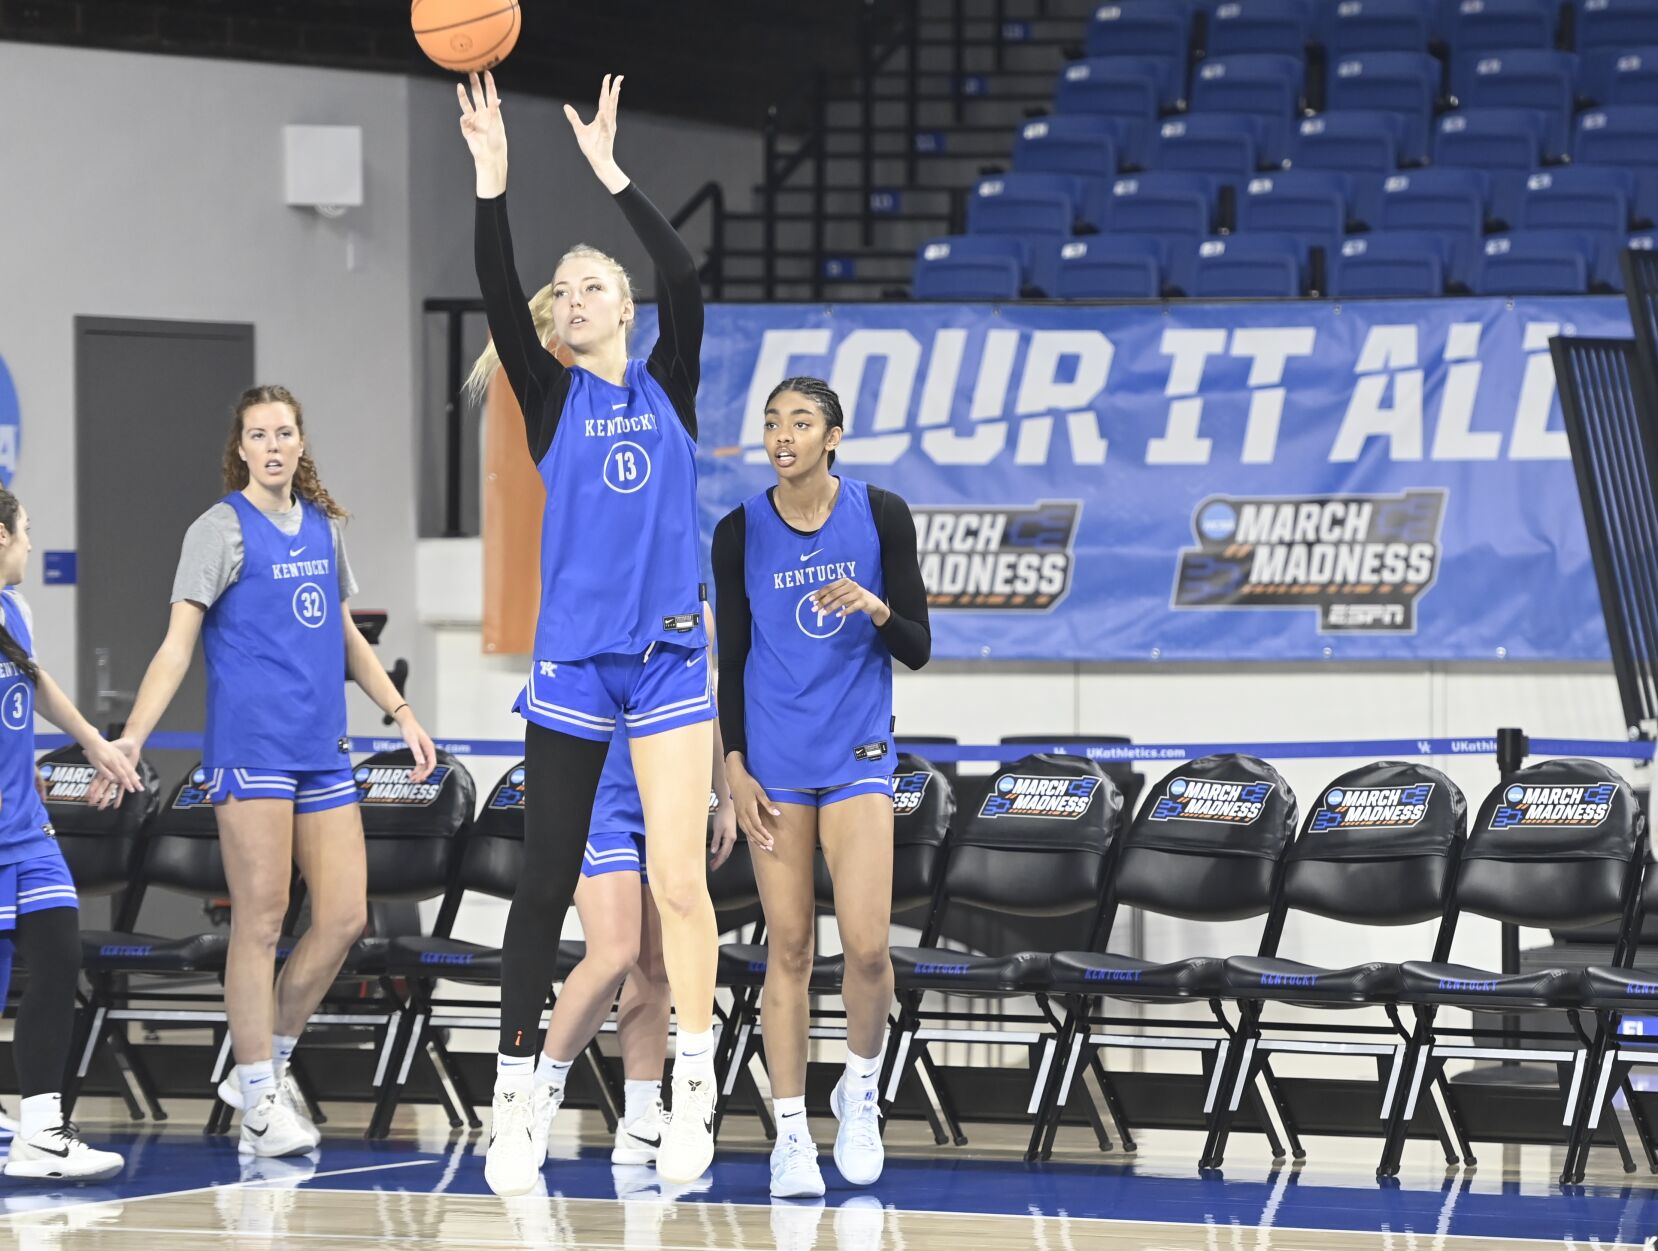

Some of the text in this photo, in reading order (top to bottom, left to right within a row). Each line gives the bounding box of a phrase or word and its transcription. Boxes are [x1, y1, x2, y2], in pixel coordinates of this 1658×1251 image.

[740, 321, 1573, 466] FOUR IT ALL
[585, 413, 657, 437] KENTUCKY
[615, 451, 637, 481] 13
[913, 513, 1008, 551] ARCH
[1234, 503, 1373, 543] MARCH
[272, 559, 329, 580] KENTUCKY
[1249, 543, 1435, 584] MADNESS
[773, 561, 857, 590] KENTUCKY
[917, 553, 1067, 595] ADNESS
[301, 591, 322, 618] 32
[1327, 603, 1405, 626] ESPN
[12, 692, 23, 719] 3
[1086, 746, 1186, 760] UKathletics.com
[366, 768, 413, 784] MARC
[366, 783, 440, 800] MADNESS
[1012, 778, 1070, 796] MARCH
[1183, 781, 1242, 801] MARCH
[1522, 788, 1584, 804] MARCH
[1012, 794, 1090, 812] MADNESS
[1184, 798, 1262, 818] MADNESS
[1341, 789, 1402, 807] MARCH
[1344, 804, 1425, 822] MADNESS
[1525, 803, 1608, 820] MADNESS
[1084, 968, 1142, 982] KENTUCKY
[1260, 973, 1318, 987] KENTUCKY
[1439, 979, 1498, 992] KENTUCKY
